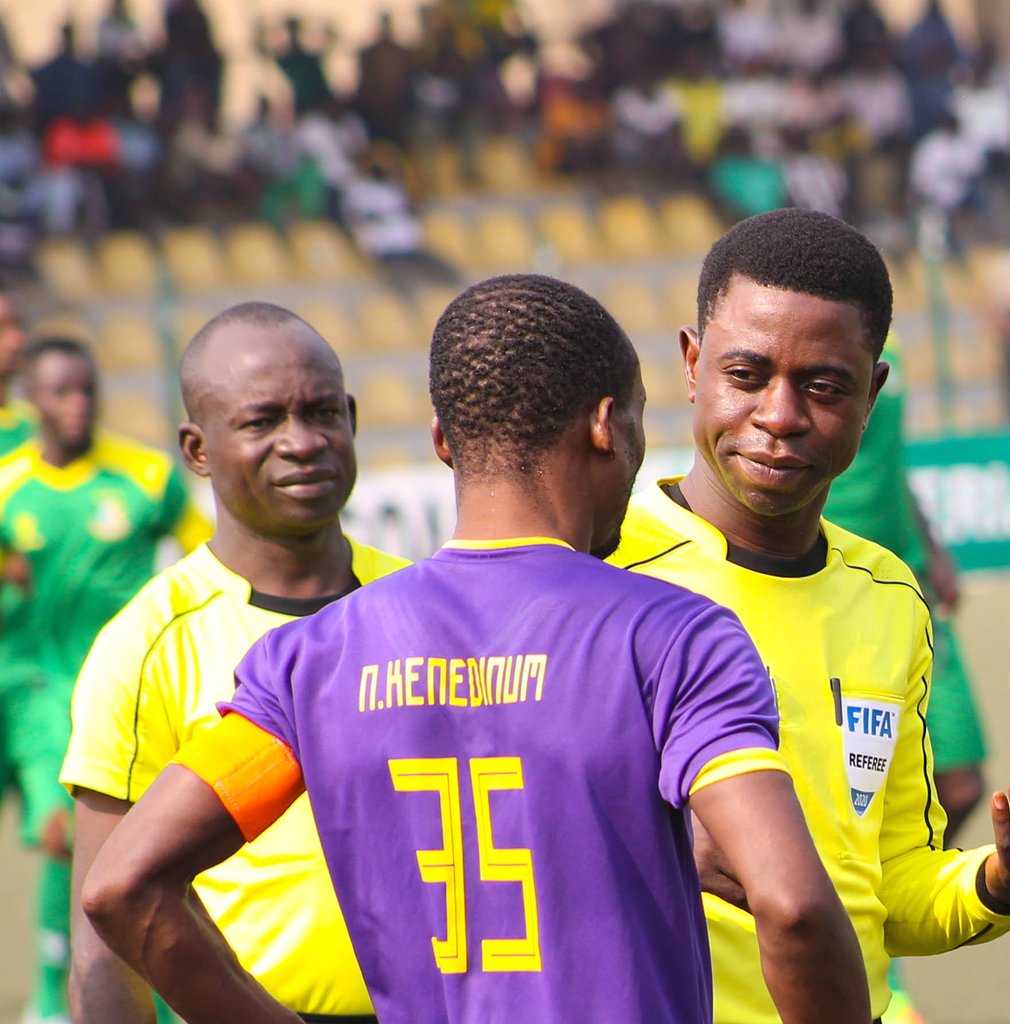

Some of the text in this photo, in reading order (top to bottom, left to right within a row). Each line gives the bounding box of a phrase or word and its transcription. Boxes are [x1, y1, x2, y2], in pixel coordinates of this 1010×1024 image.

[847, 706, 892, 738] FIFA
[849, 753, 887, 772] REFEREE
[854, 793, 869, 807] 2020
[388, 757, 542, 974] 35
